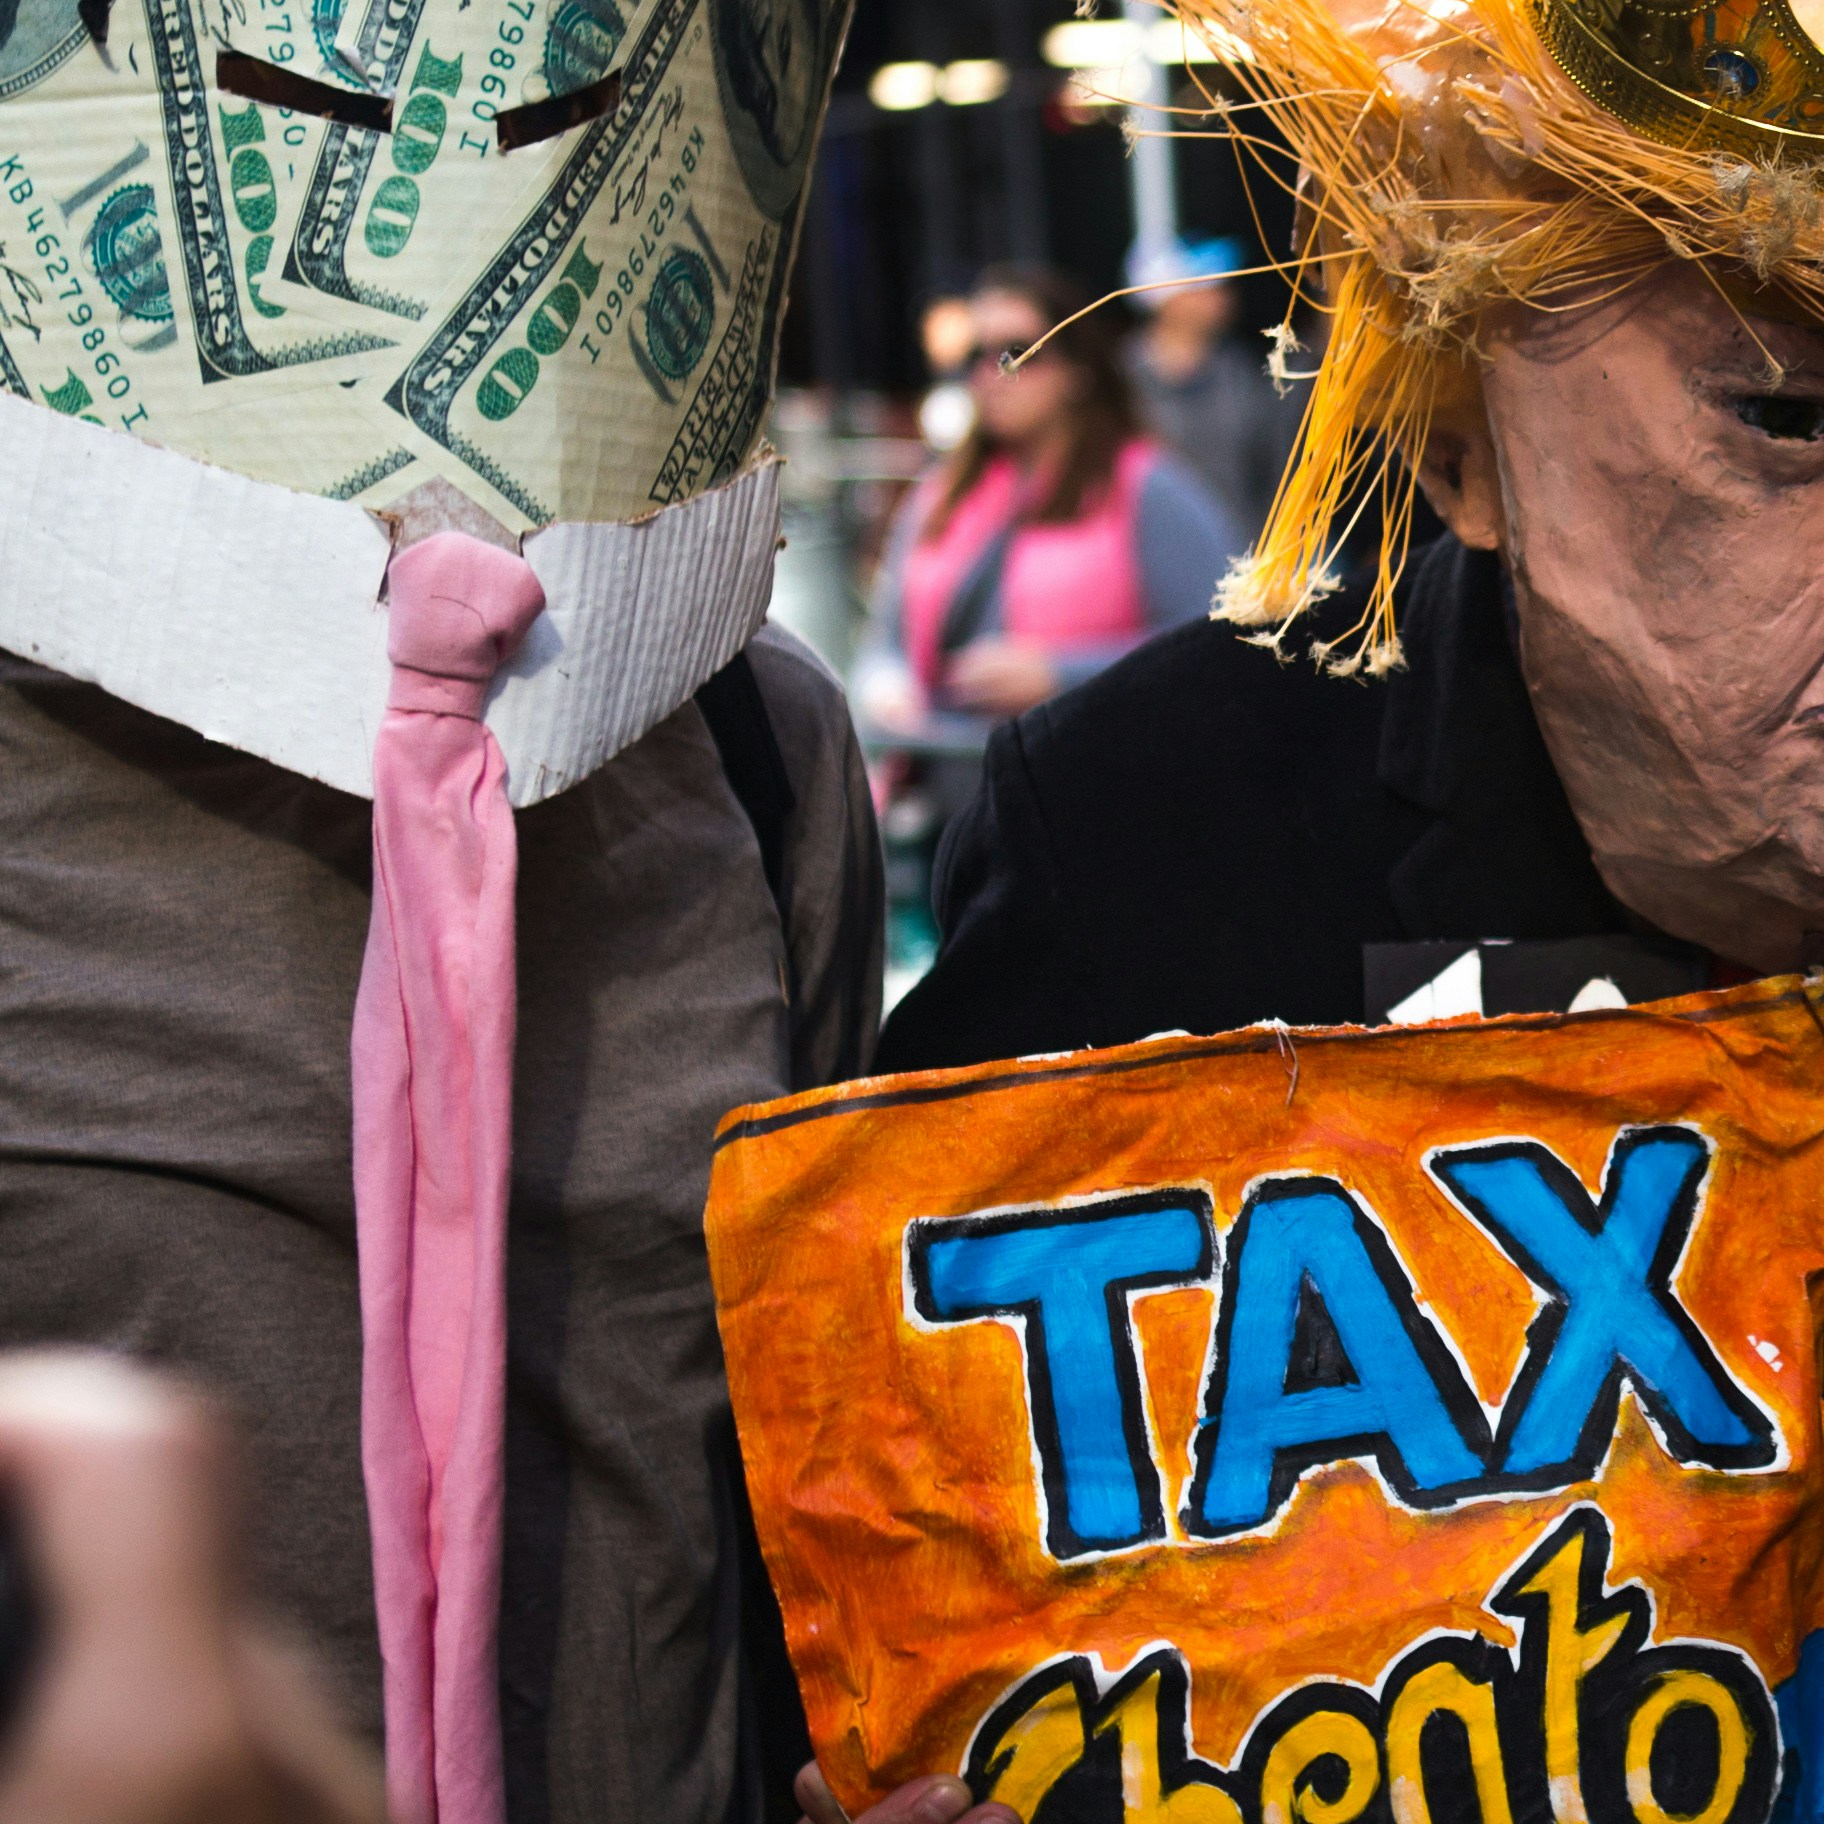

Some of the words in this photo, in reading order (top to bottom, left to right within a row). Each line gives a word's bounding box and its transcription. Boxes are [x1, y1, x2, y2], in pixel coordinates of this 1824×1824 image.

[309, 28, 402, 258] DOLARS
[354, 36, 473, 267] 100
[558, 21, 676, 213] HUNDRED
[677, 124, 711, 171] KB
[0, 151, 39, 208] KB
[20, 206, 135, 403] 46279860
[174, 109, 239, 350] DOLLARS
[418, 206, 572, 398] DOLLARS
[464, 235, 618, 432] 100
[590, 170, 692, 339] 46279860
[908, 1123, 1786, 1559] TAX
